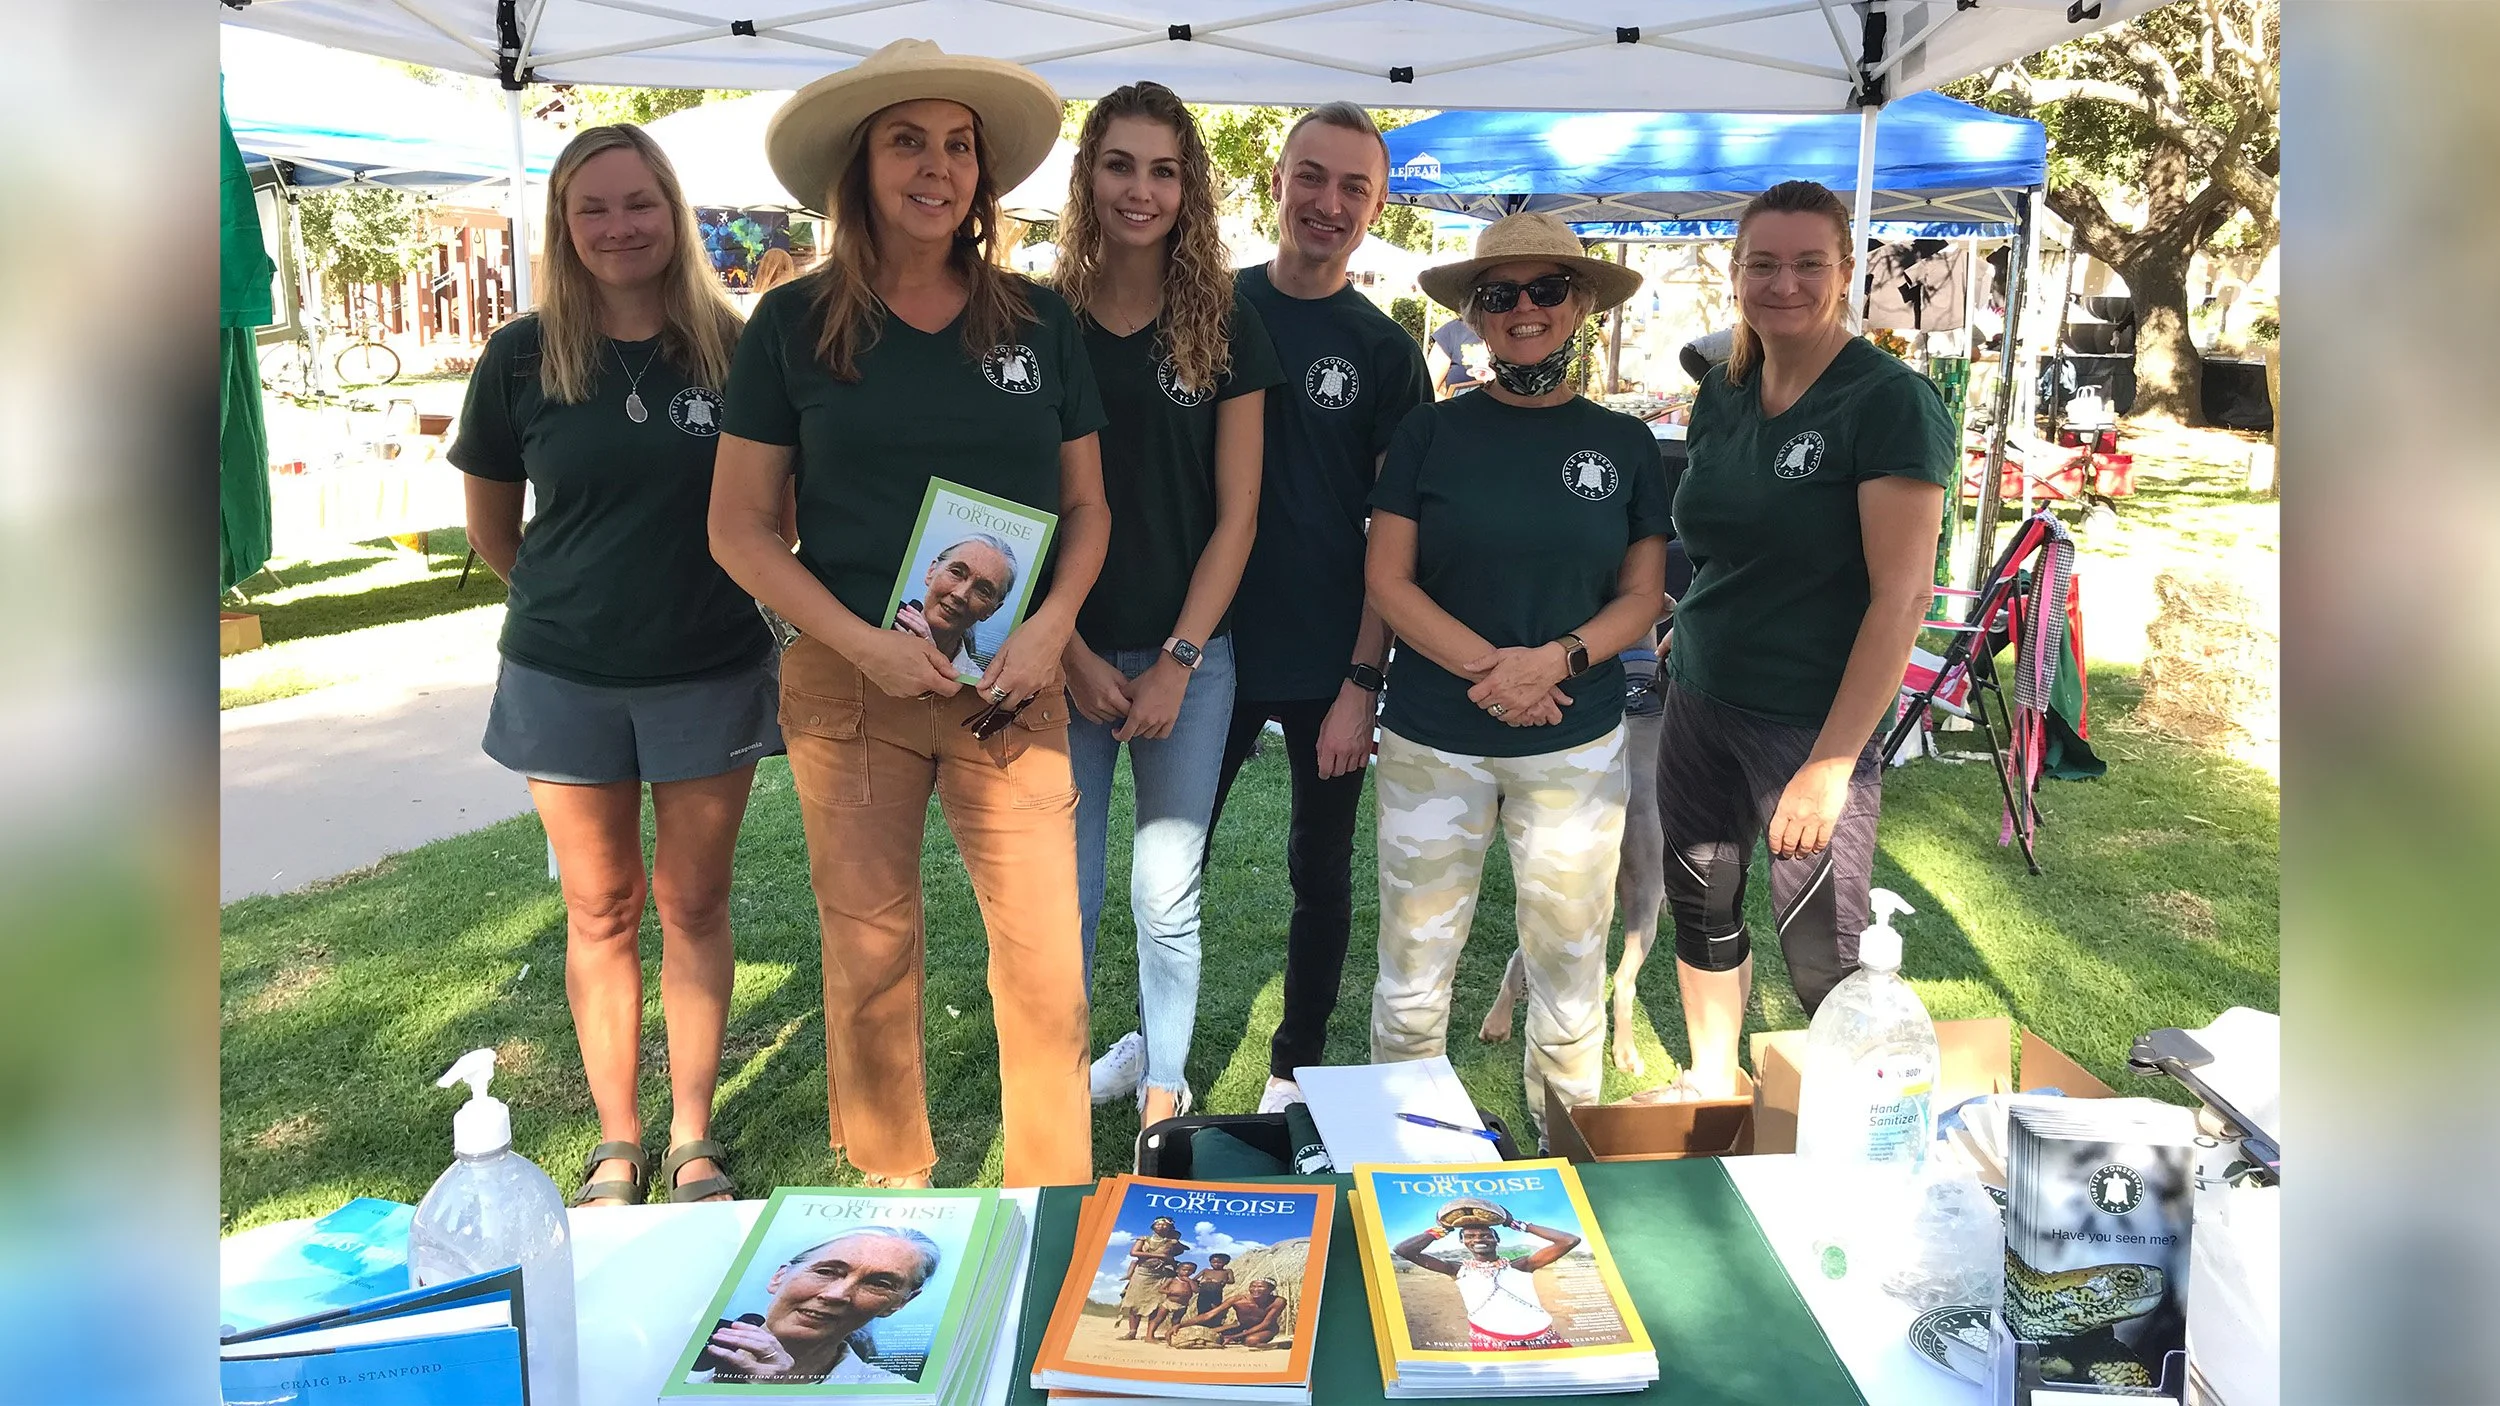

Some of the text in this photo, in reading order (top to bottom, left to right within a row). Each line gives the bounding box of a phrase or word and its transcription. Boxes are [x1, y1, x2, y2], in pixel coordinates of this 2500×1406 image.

[1308, 358, 1358, 402] TURTLE CONSERVANCY
[1179, 394, 1190, 403] TC
[1323, 398, 1335, 406] TC
[671, 396, 684, 424] TURTLE
[1564, 452, 1616, 493] TURTLE CONSERVANCY
[1584, 489, 1596, 498] TC
[946, 500, 1033, 541] TORTOISE
[1870, 1103, 1901, 1114] Hand
[1869, 1114, 1920, 1127] Sanitizer
[1392, 1176, 1545, 1195] TORTOISE
[1431, 1175, 1459, 1185] THE
[2090, 1165, 2143, 1205] TURTLE CONSERVANCY
[1146, 1193, 1296, 1215] TORTOISE
[1187, 1191, 1217, 1200] THE
[802, 1203, 957, 1220] TORTOISE
[2110, 1205, 2123, 1213] TC
[2051, 1228, 2178, 1246] Have you seen me?
[280, 1362, 442, 1391] CRAIG B. STANFORD
